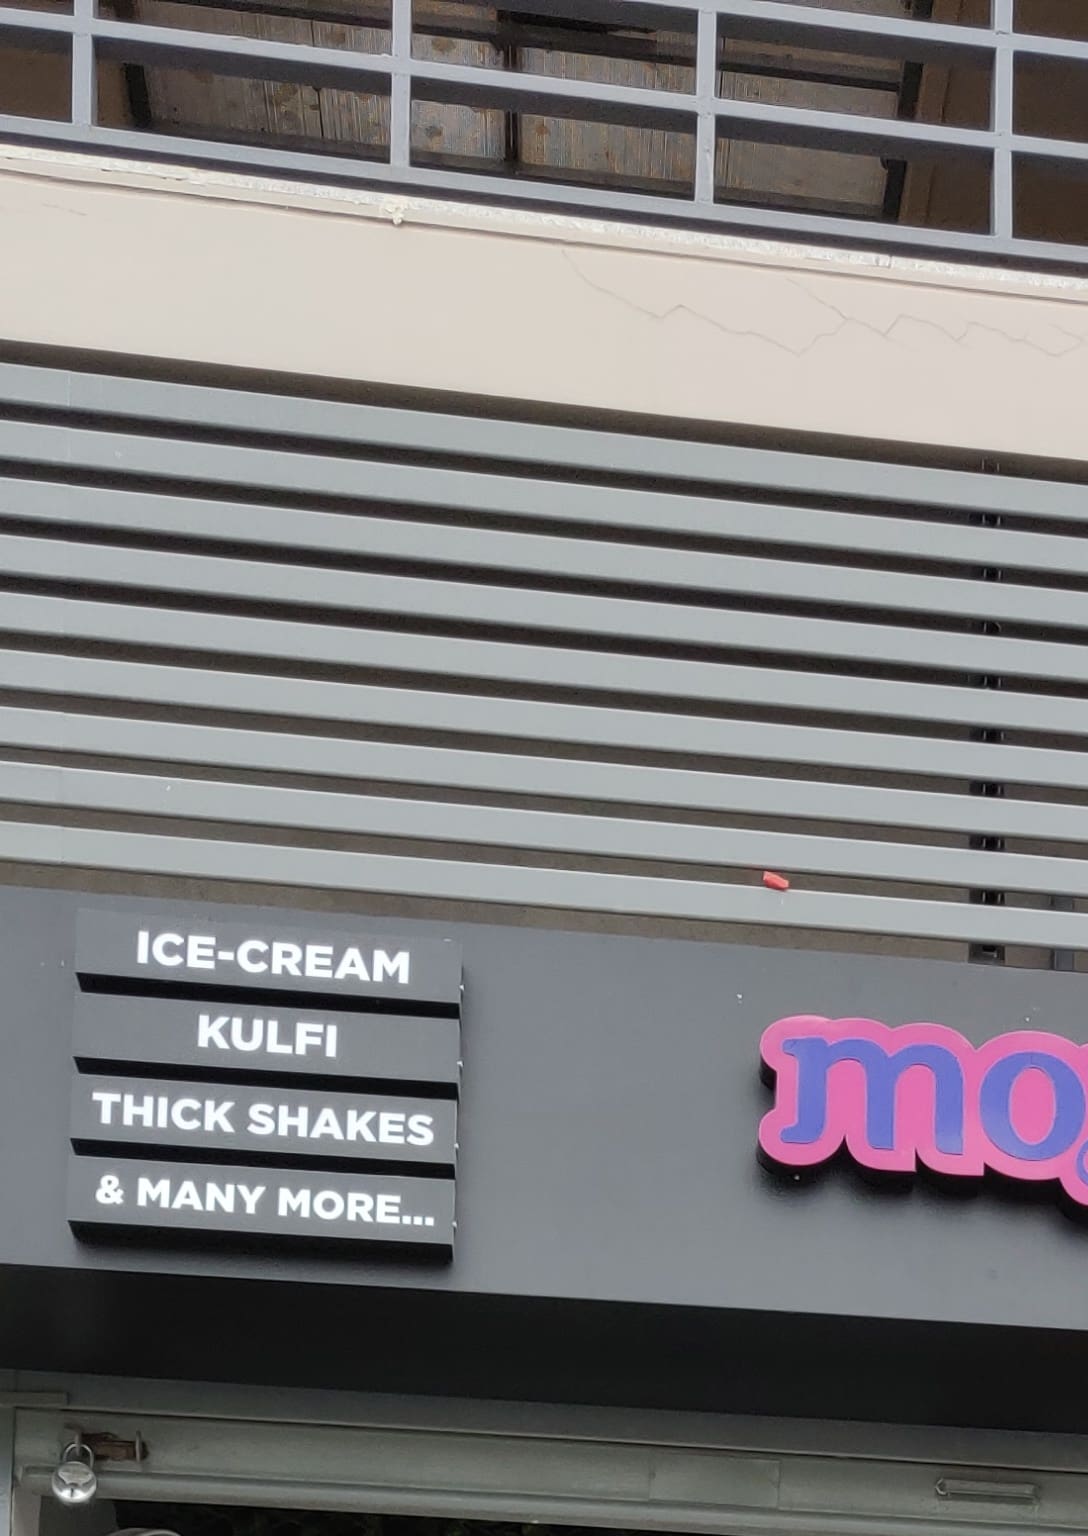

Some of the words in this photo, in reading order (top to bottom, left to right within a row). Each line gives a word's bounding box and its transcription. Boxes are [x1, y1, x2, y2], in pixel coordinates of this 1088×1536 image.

[137, 930, 411, 984] ICE-CREAM
[197, 1014, 338, 1058] KULFI
[92, 1092, 236, 1134] THICK
[247, 1103, 435, 1147] SHAKES
[95, 1174, 125, 1206] &
[137, 1178, 266, 1216] MANY
[278, 1188, 435, 1227] MORE...
